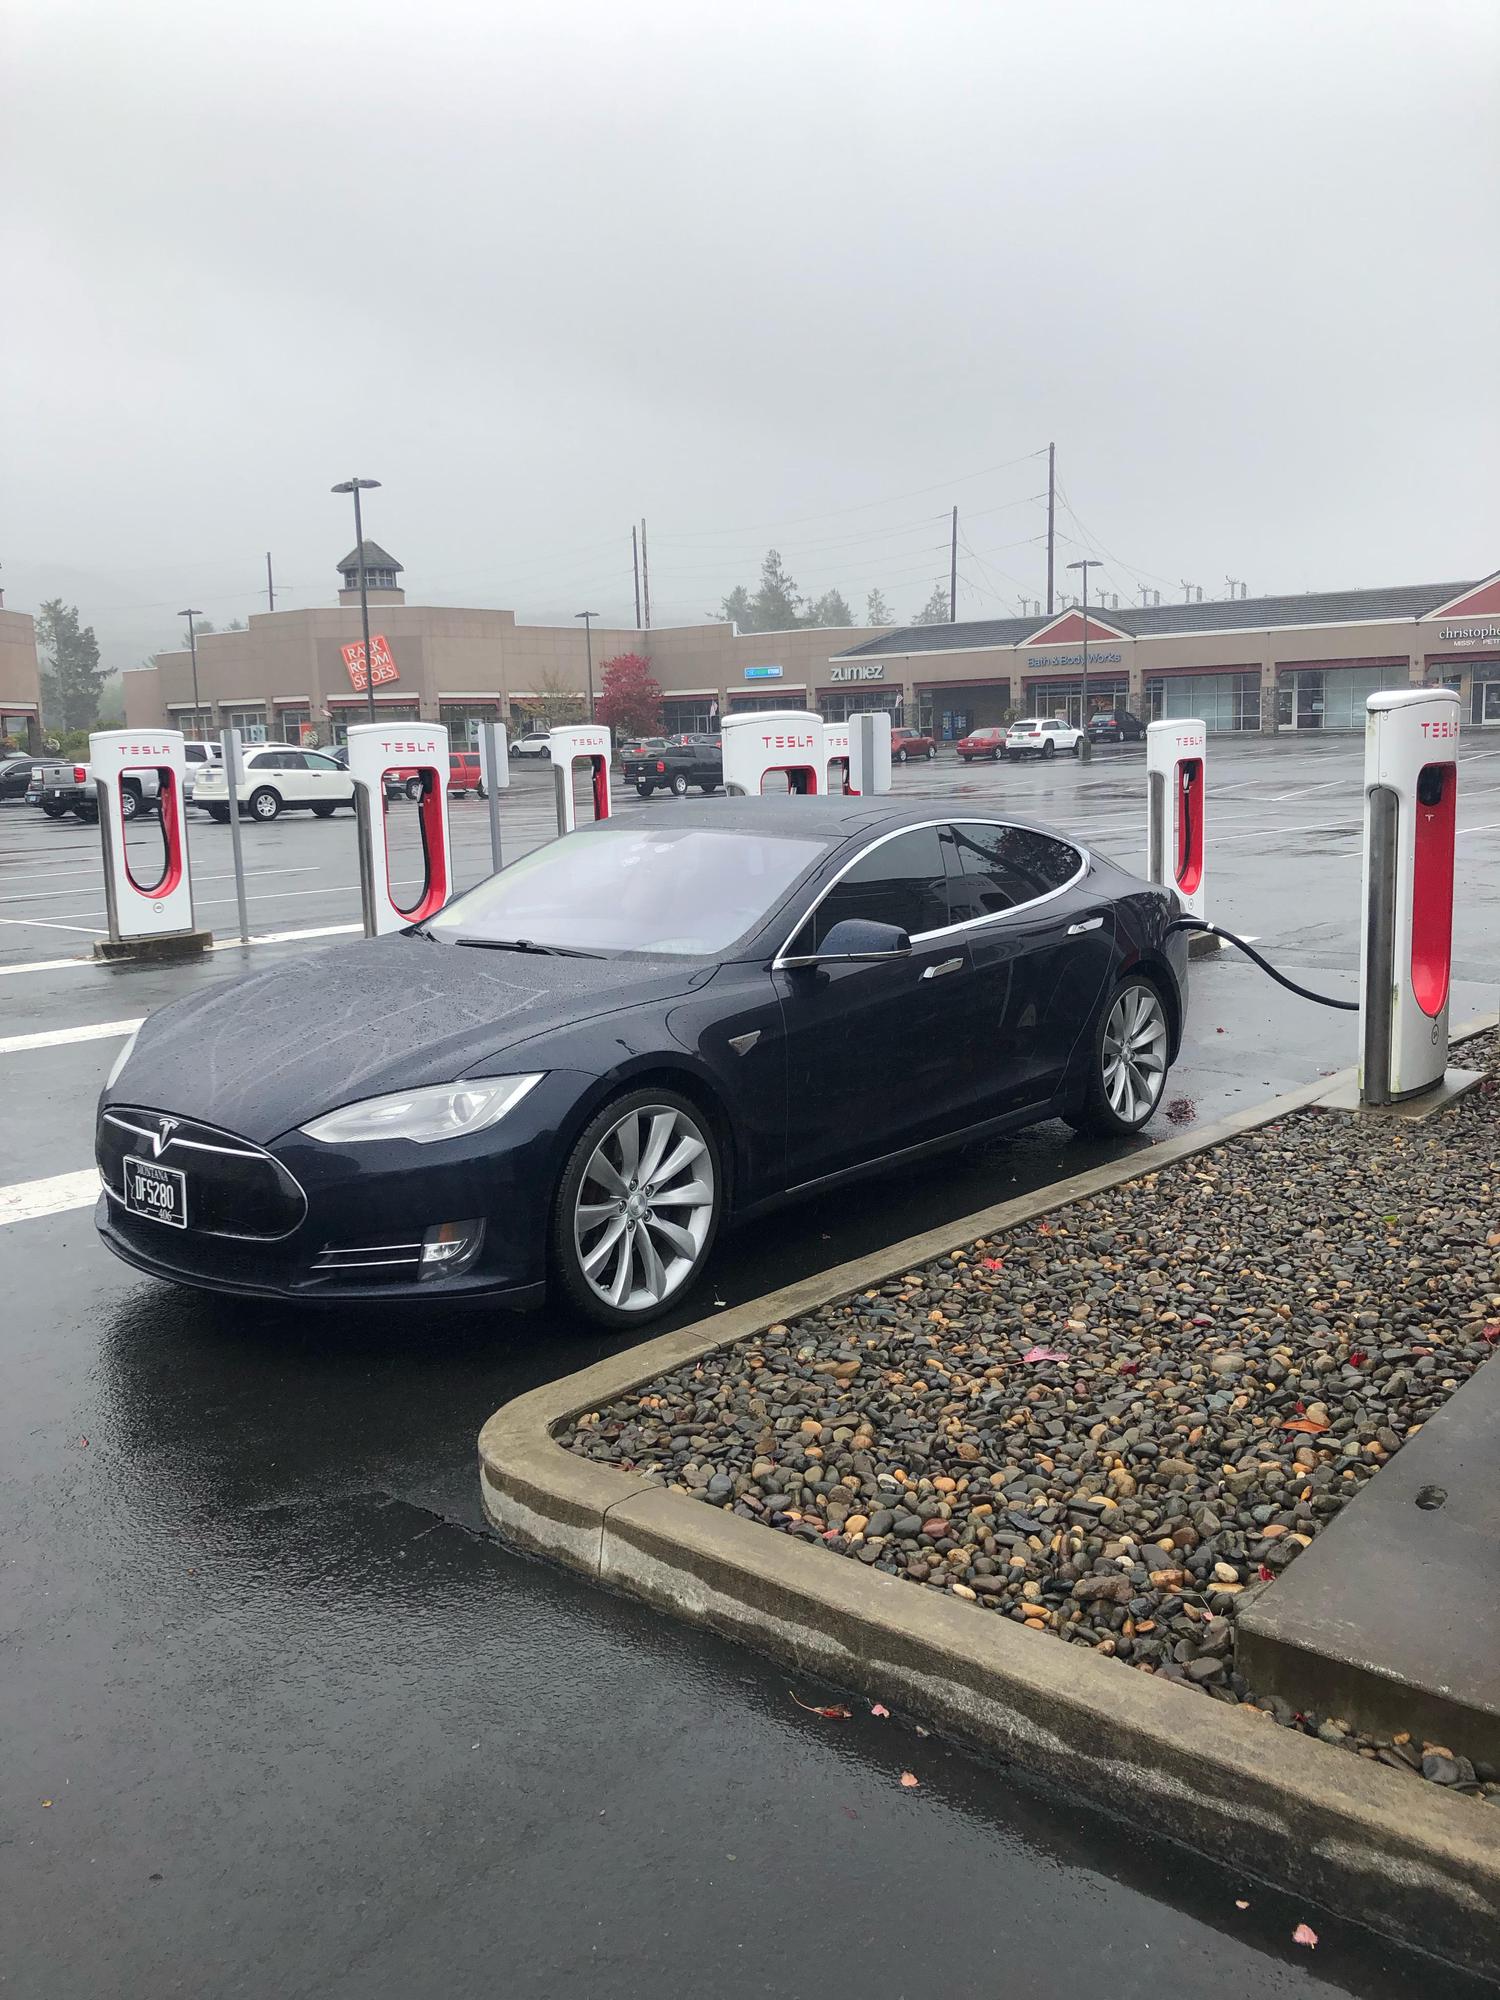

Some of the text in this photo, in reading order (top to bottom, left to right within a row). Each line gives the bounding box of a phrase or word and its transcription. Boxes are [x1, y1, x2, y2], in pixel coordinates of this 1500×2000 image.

[350, 652, 389, 673] ROOM
[1028, 652, 1121, 668] Bath & Body Works
[831, 665, 884, 681] zumiez
[1421, 721, 1458, 739] TESLA
[381, 742, 436, 753] TESLA
[571, 738, 604, 746] TESLA
[762, 735, 814, 748] TESLA
[828, 737, 848, 746] TES
[1175, 736, 1203, 747] TESLA
[118, 745, 170, 755] TESLA
[136, 1163, 169, 1182] MONTANA
[158, 1208, 172, 1221] 406
